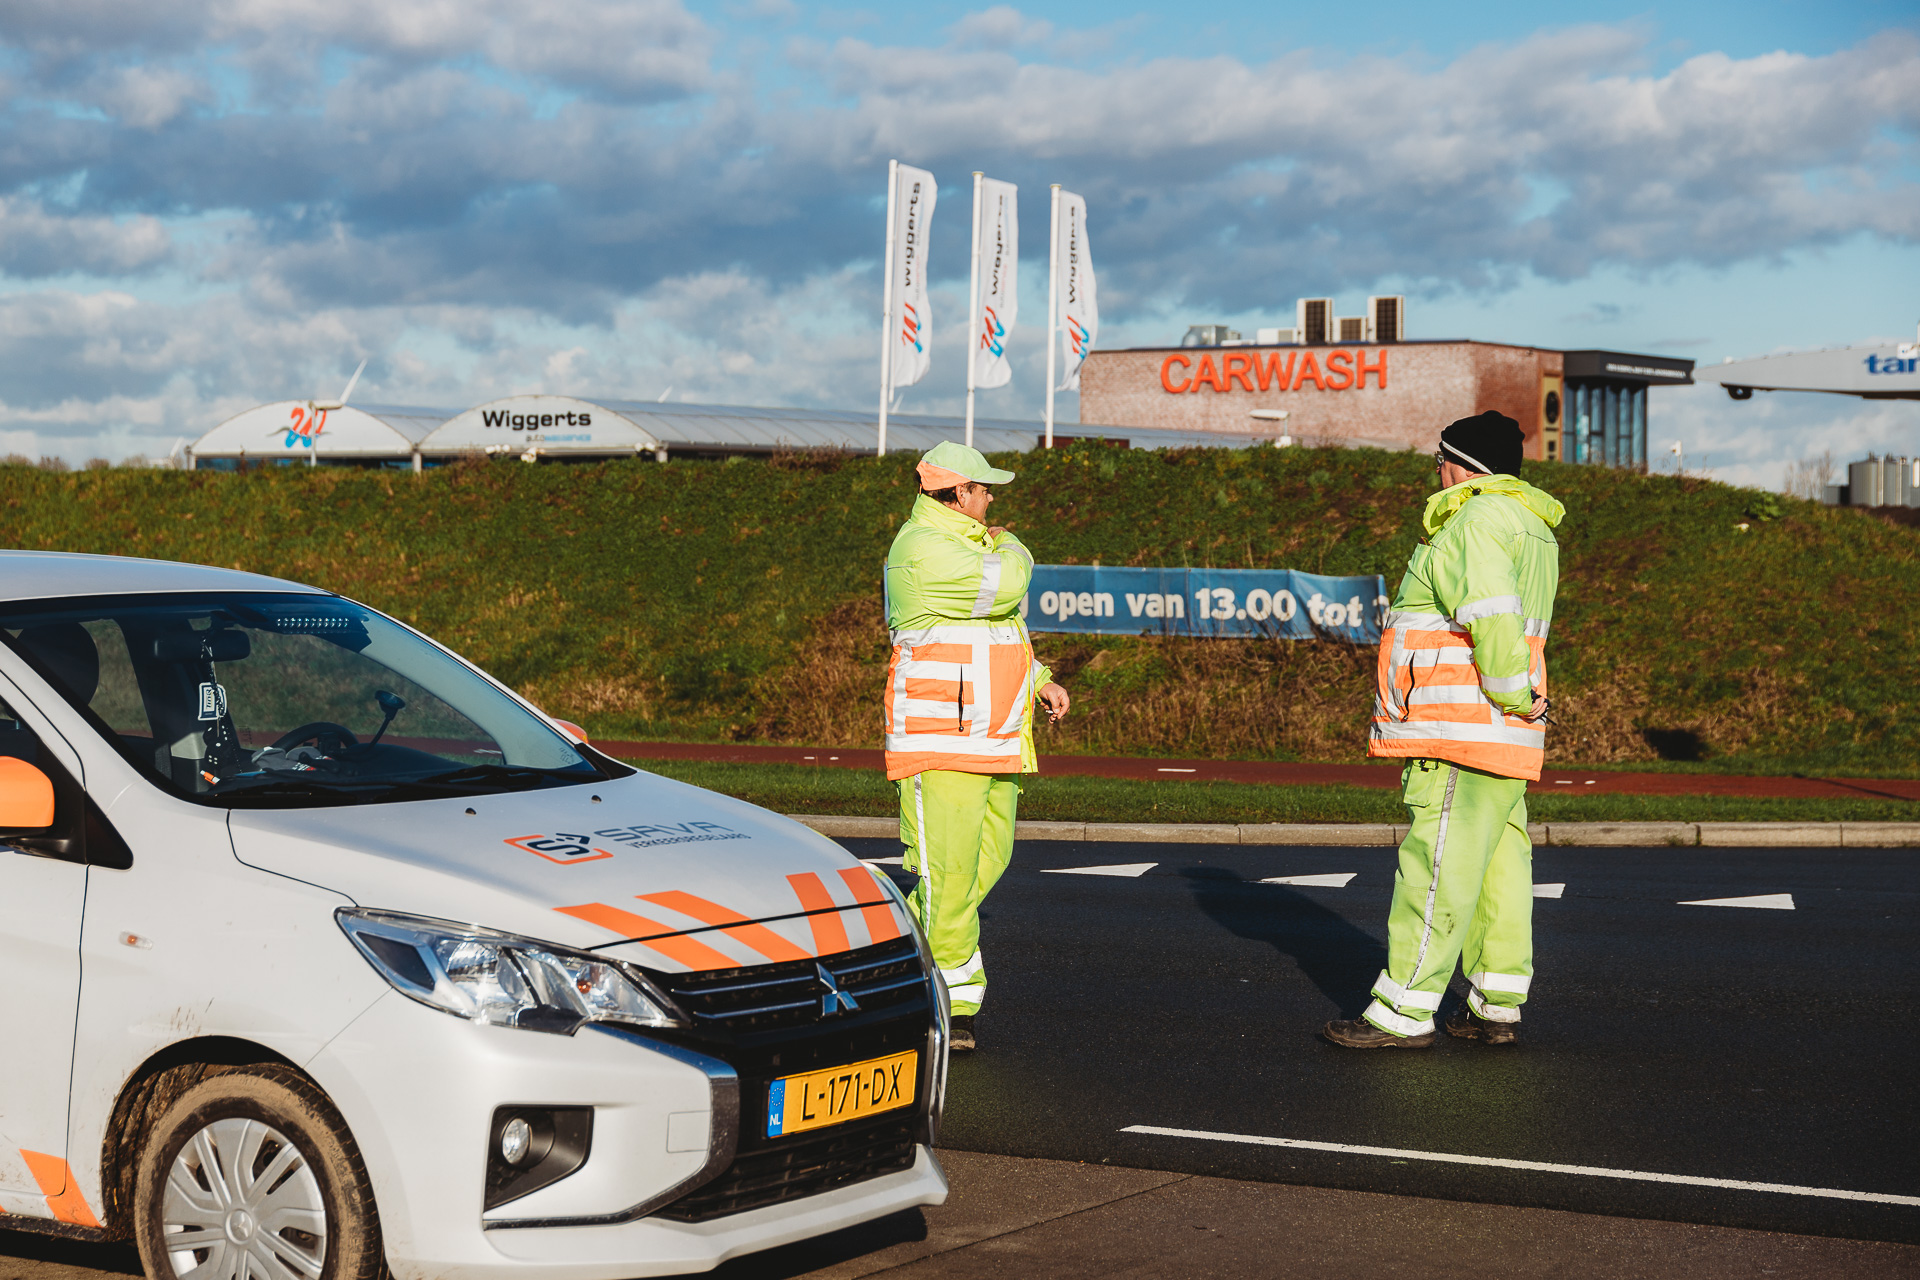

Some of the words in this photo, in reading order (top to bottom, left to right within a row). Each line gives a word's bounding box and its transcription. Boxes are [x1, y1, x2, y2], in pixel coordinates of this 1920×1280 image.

[1160, 349, 1388, 394] CARWASH
[482, 410, 592, 431] Wiggerts
[1040, 590, 1114, 622] open
[1125, 593, 1185, 618] van
[1195, 587, 1297, 622] 13.00
[1306, 593, 1364, 627] tot
[594, 821, 735, 842] SAVA
[801, 1061, 903, 1122] L-171-DX
[769, 1113, 781, 1126] NL
